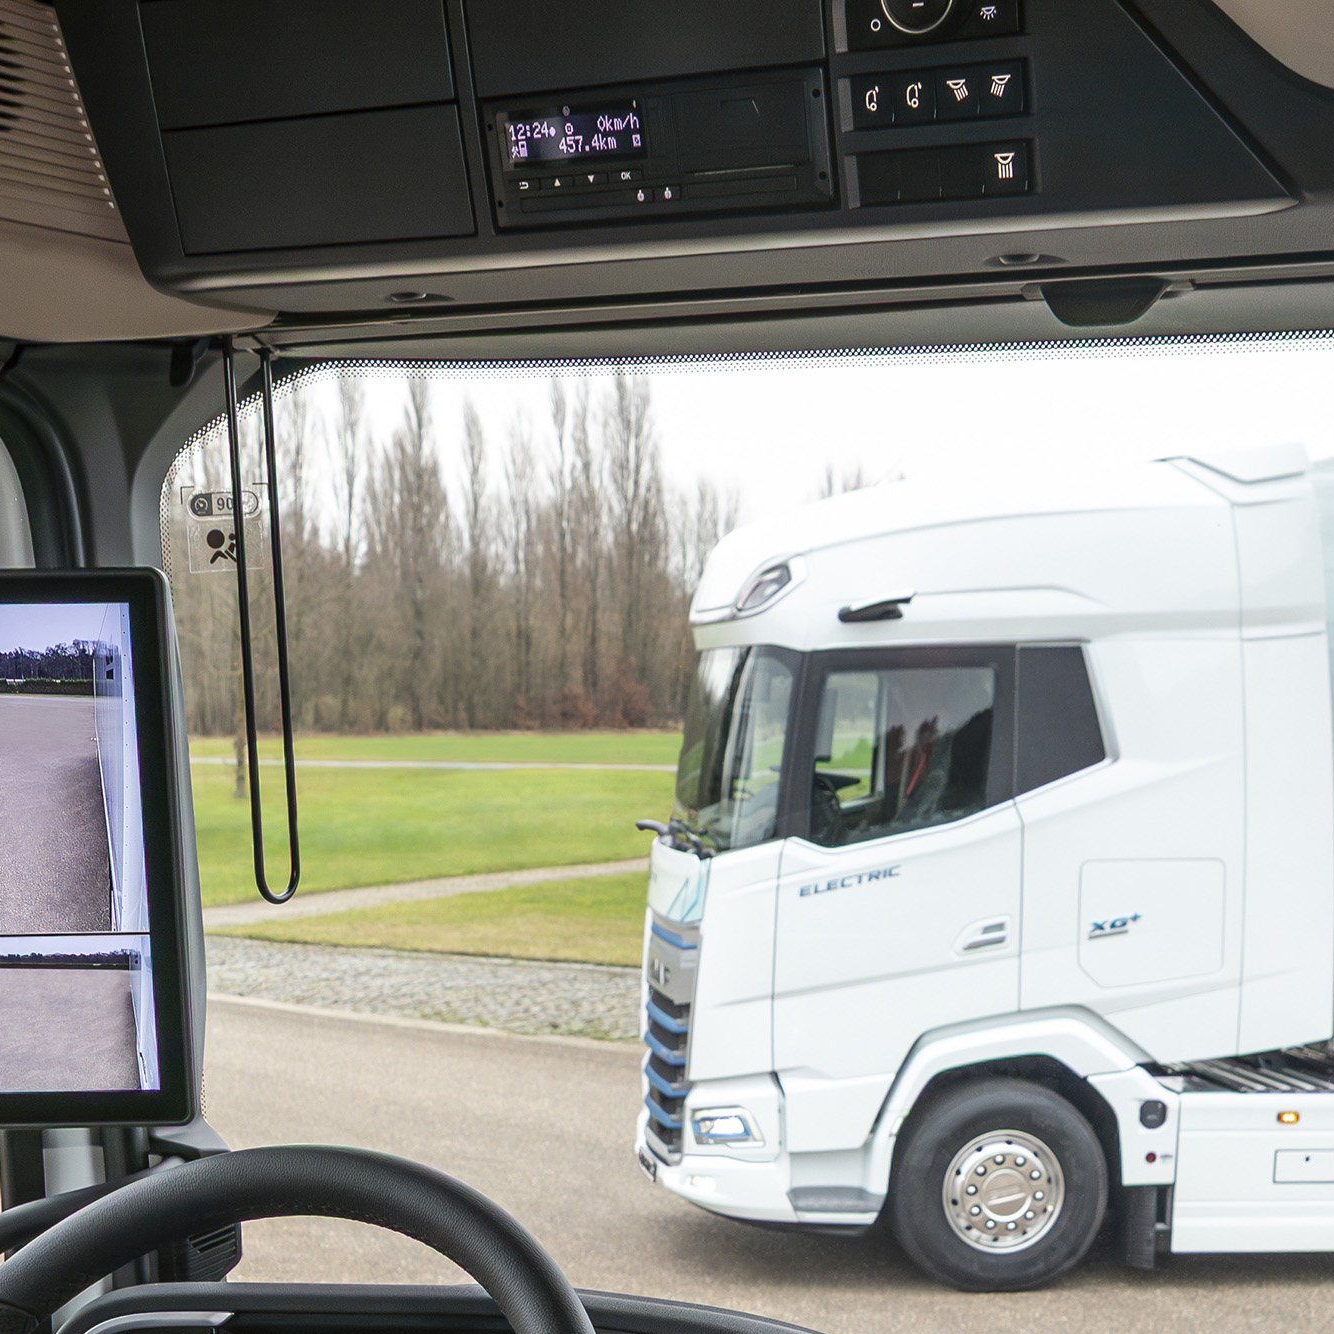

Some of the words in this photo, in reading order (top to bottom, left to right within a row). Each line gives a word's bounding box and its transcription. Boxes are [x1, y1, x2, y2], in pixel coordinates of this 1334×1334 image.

[509, 121, 549, 141] 12:24
[597, 112, 640, 132] 0km/h
[620, 171, 632, 181] OK
[799, 864, 902, 897] ELECTRIC
